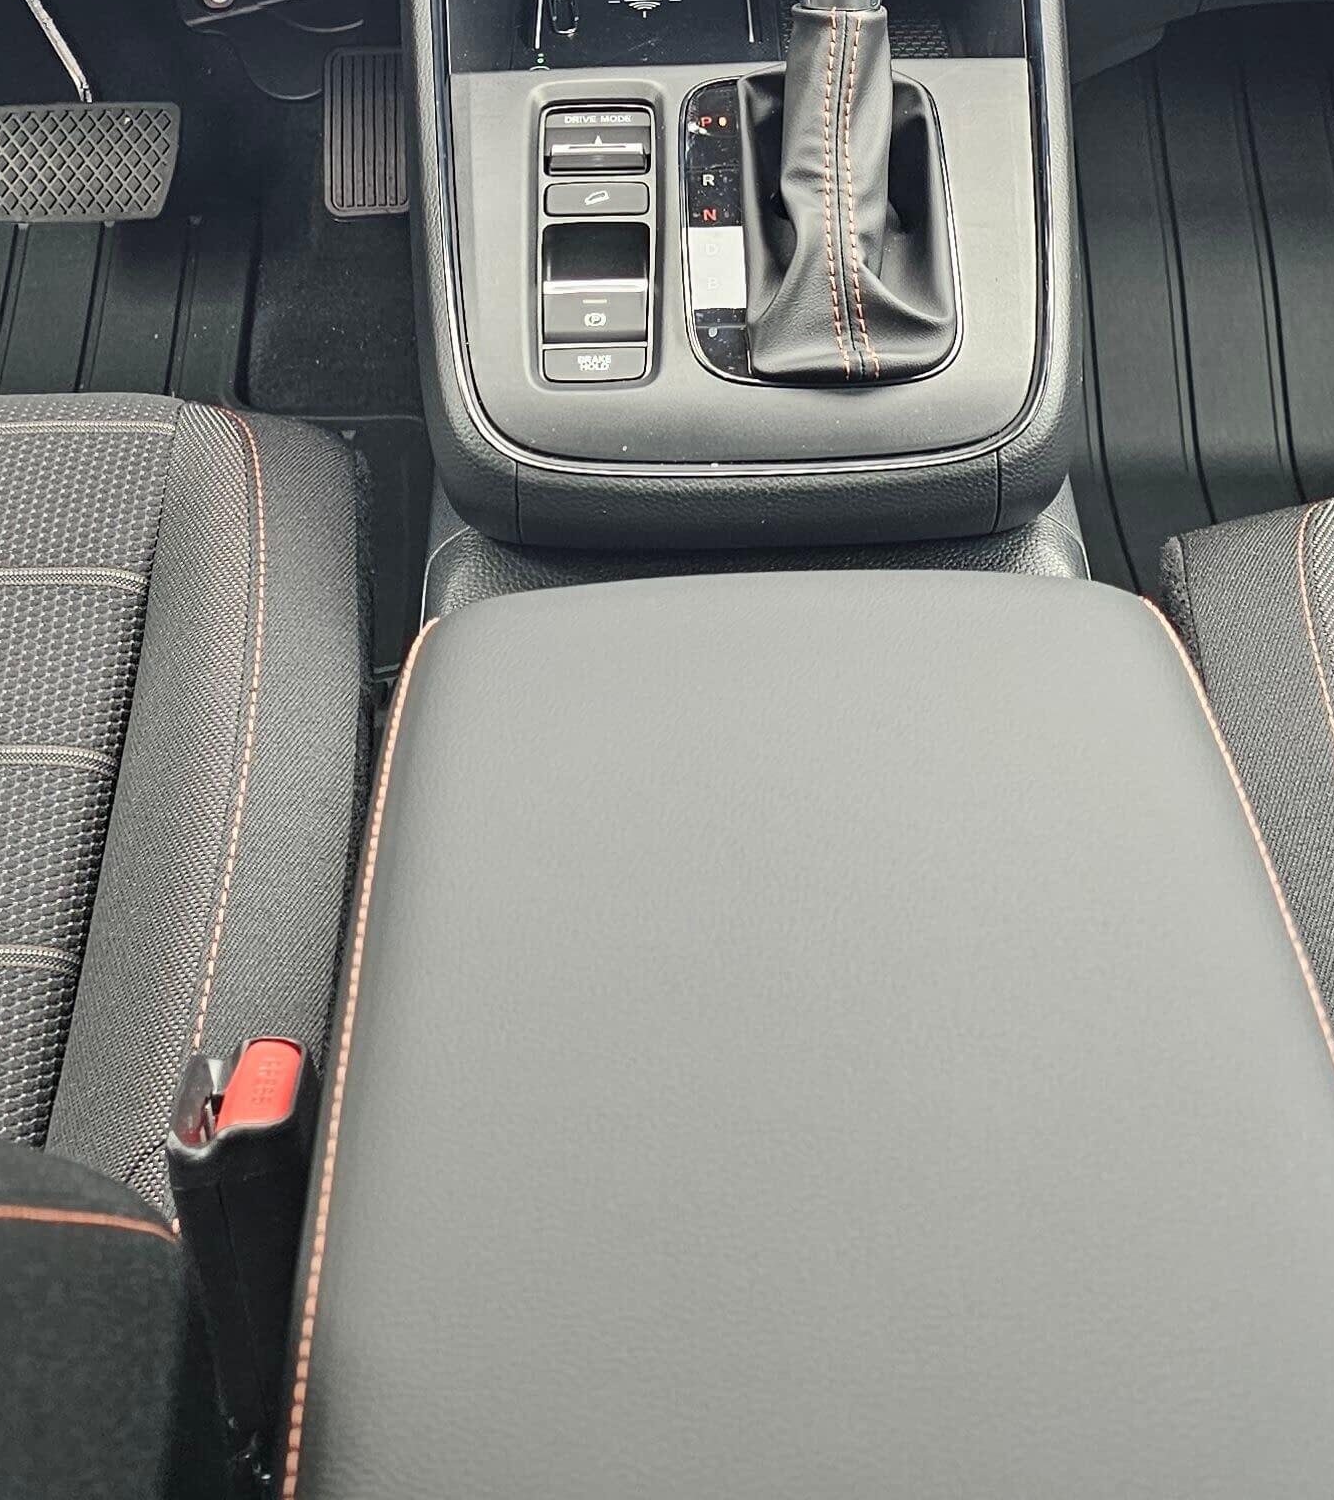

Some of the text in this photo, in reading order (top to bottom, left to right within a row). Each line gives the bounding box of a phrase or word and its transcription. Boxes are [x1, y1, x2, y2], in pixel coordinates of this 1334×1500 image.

[564, 114, 632, 124] DRIVE MODE
[700, 116, 712, 127] P
[702, 174, 715, 187] R
[703, 208, 717, 221] N
[706, 243, 718, 256] D
[707, 277, 718, 290] B
[577, 355, 612, 364] BRAKE
[579, 362, 610, 371] HOLD
